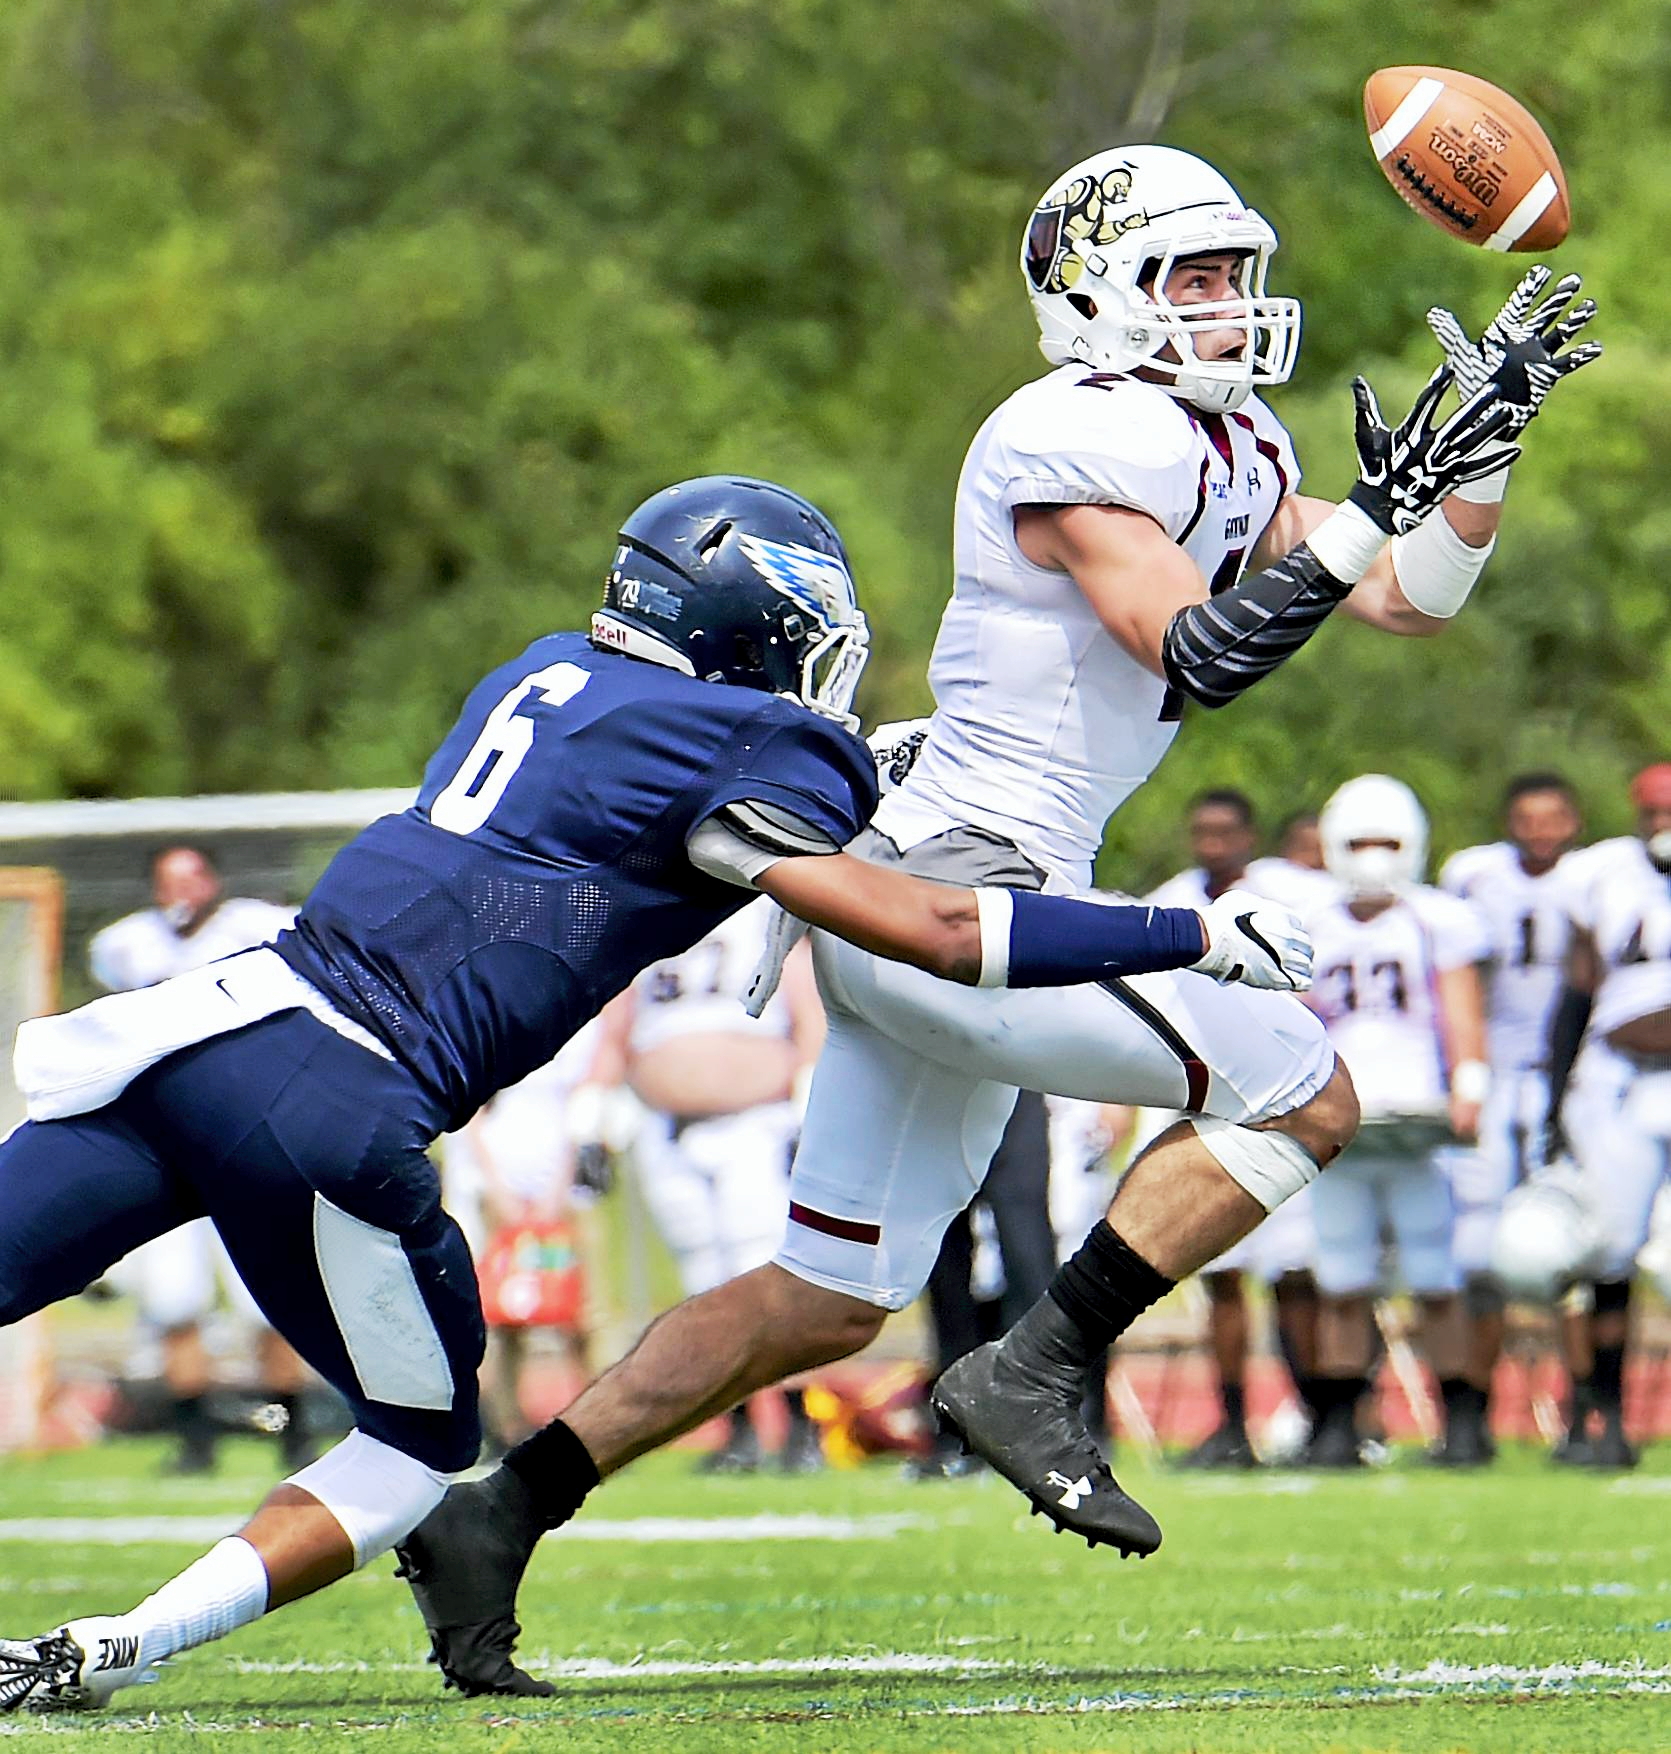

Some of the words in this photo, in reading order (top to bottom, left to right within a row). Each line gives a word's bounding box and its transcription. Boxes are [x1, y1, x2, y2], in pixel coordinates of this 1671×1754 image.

[1429, 132, 1500, 208] Wilson
[430, 660, 592, 837] 6
[93, 1634, 139, 1674] NIKE
